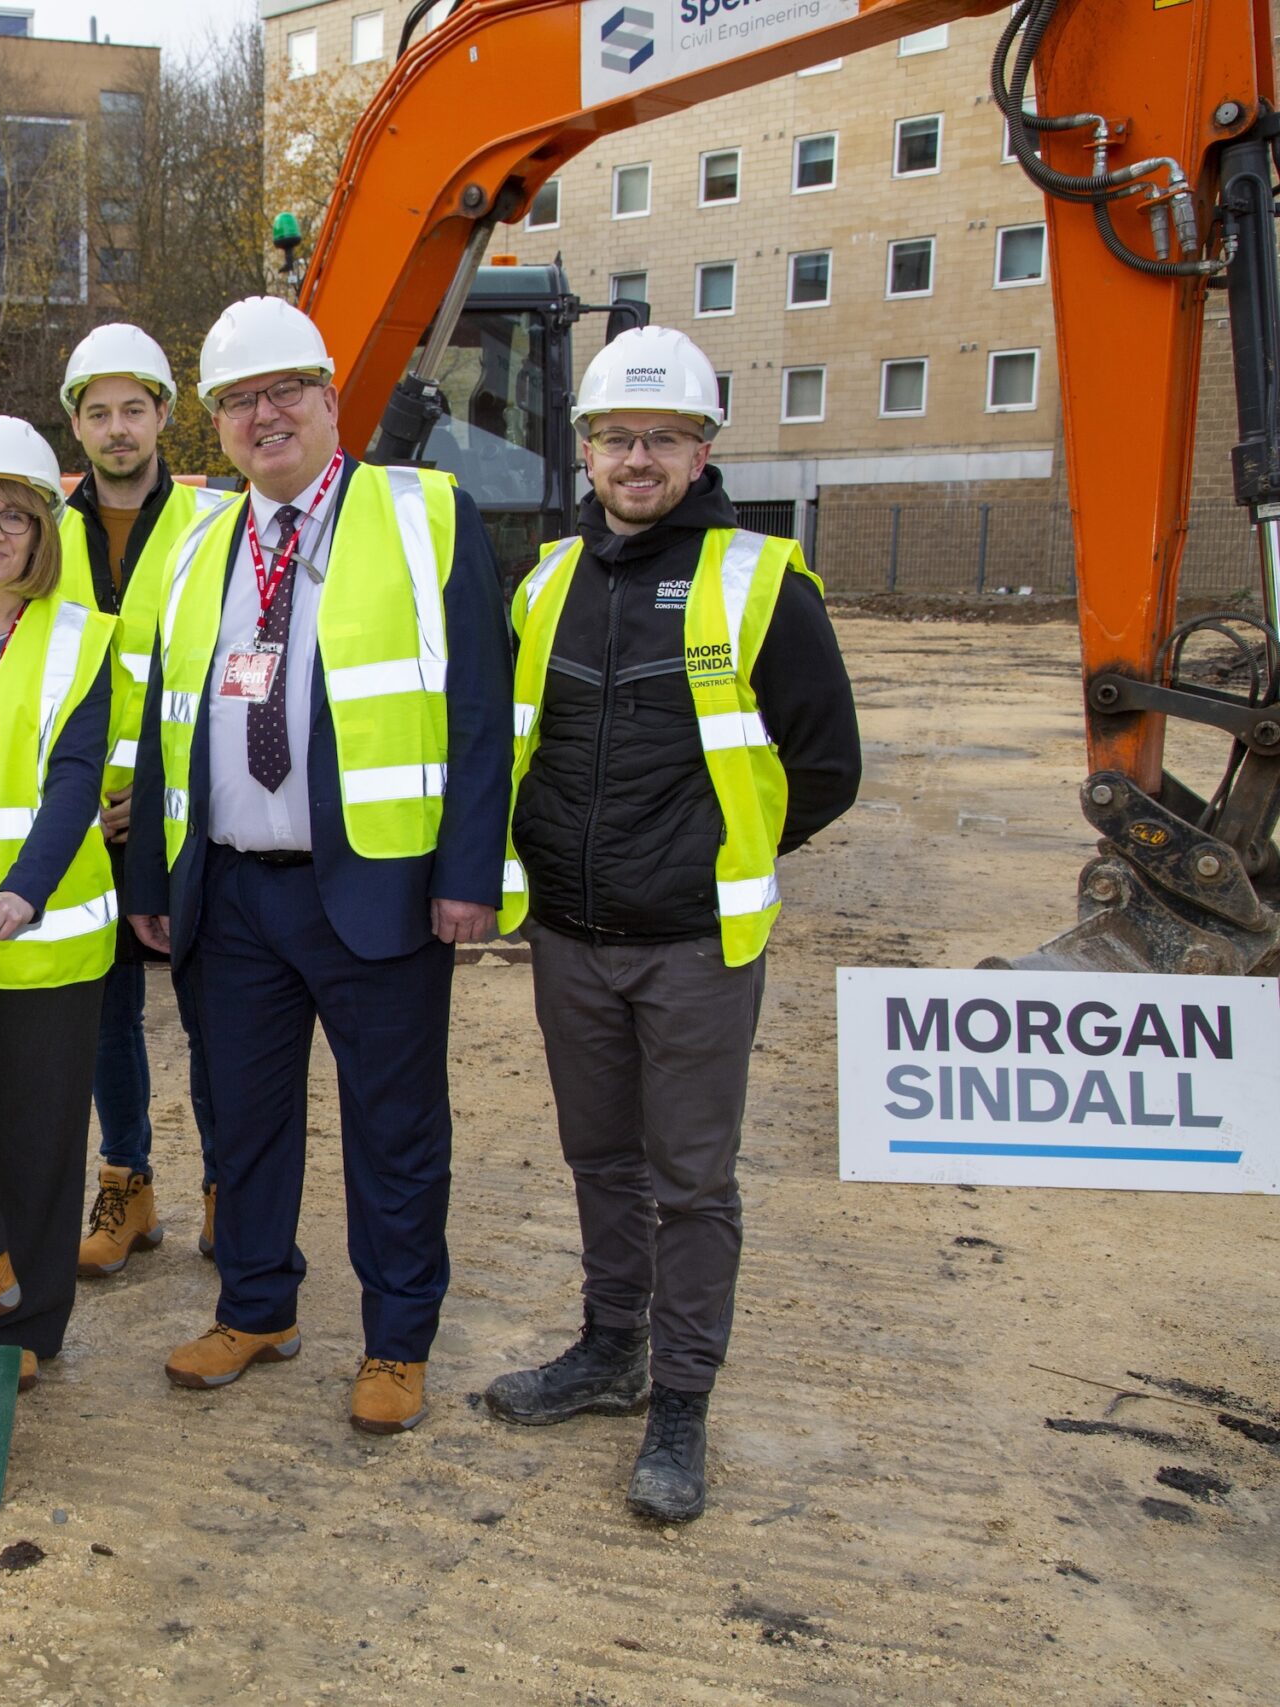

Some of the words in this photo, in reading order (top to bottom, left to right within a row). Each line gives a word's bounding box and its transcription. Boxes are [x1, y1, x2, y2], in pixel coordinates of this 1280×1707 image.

[680, 28, 713, 50] Civil
[718, 1, 821, 40] Engineering
[625, 375, 665, 383] SINDALL
[626, 367, 666, 375] MORGAN
[225, 667, 267, 684] Event
[886, 996, 1233, 1060] MORGAN
[884, 1064, 1223, 1128] SINDALL
